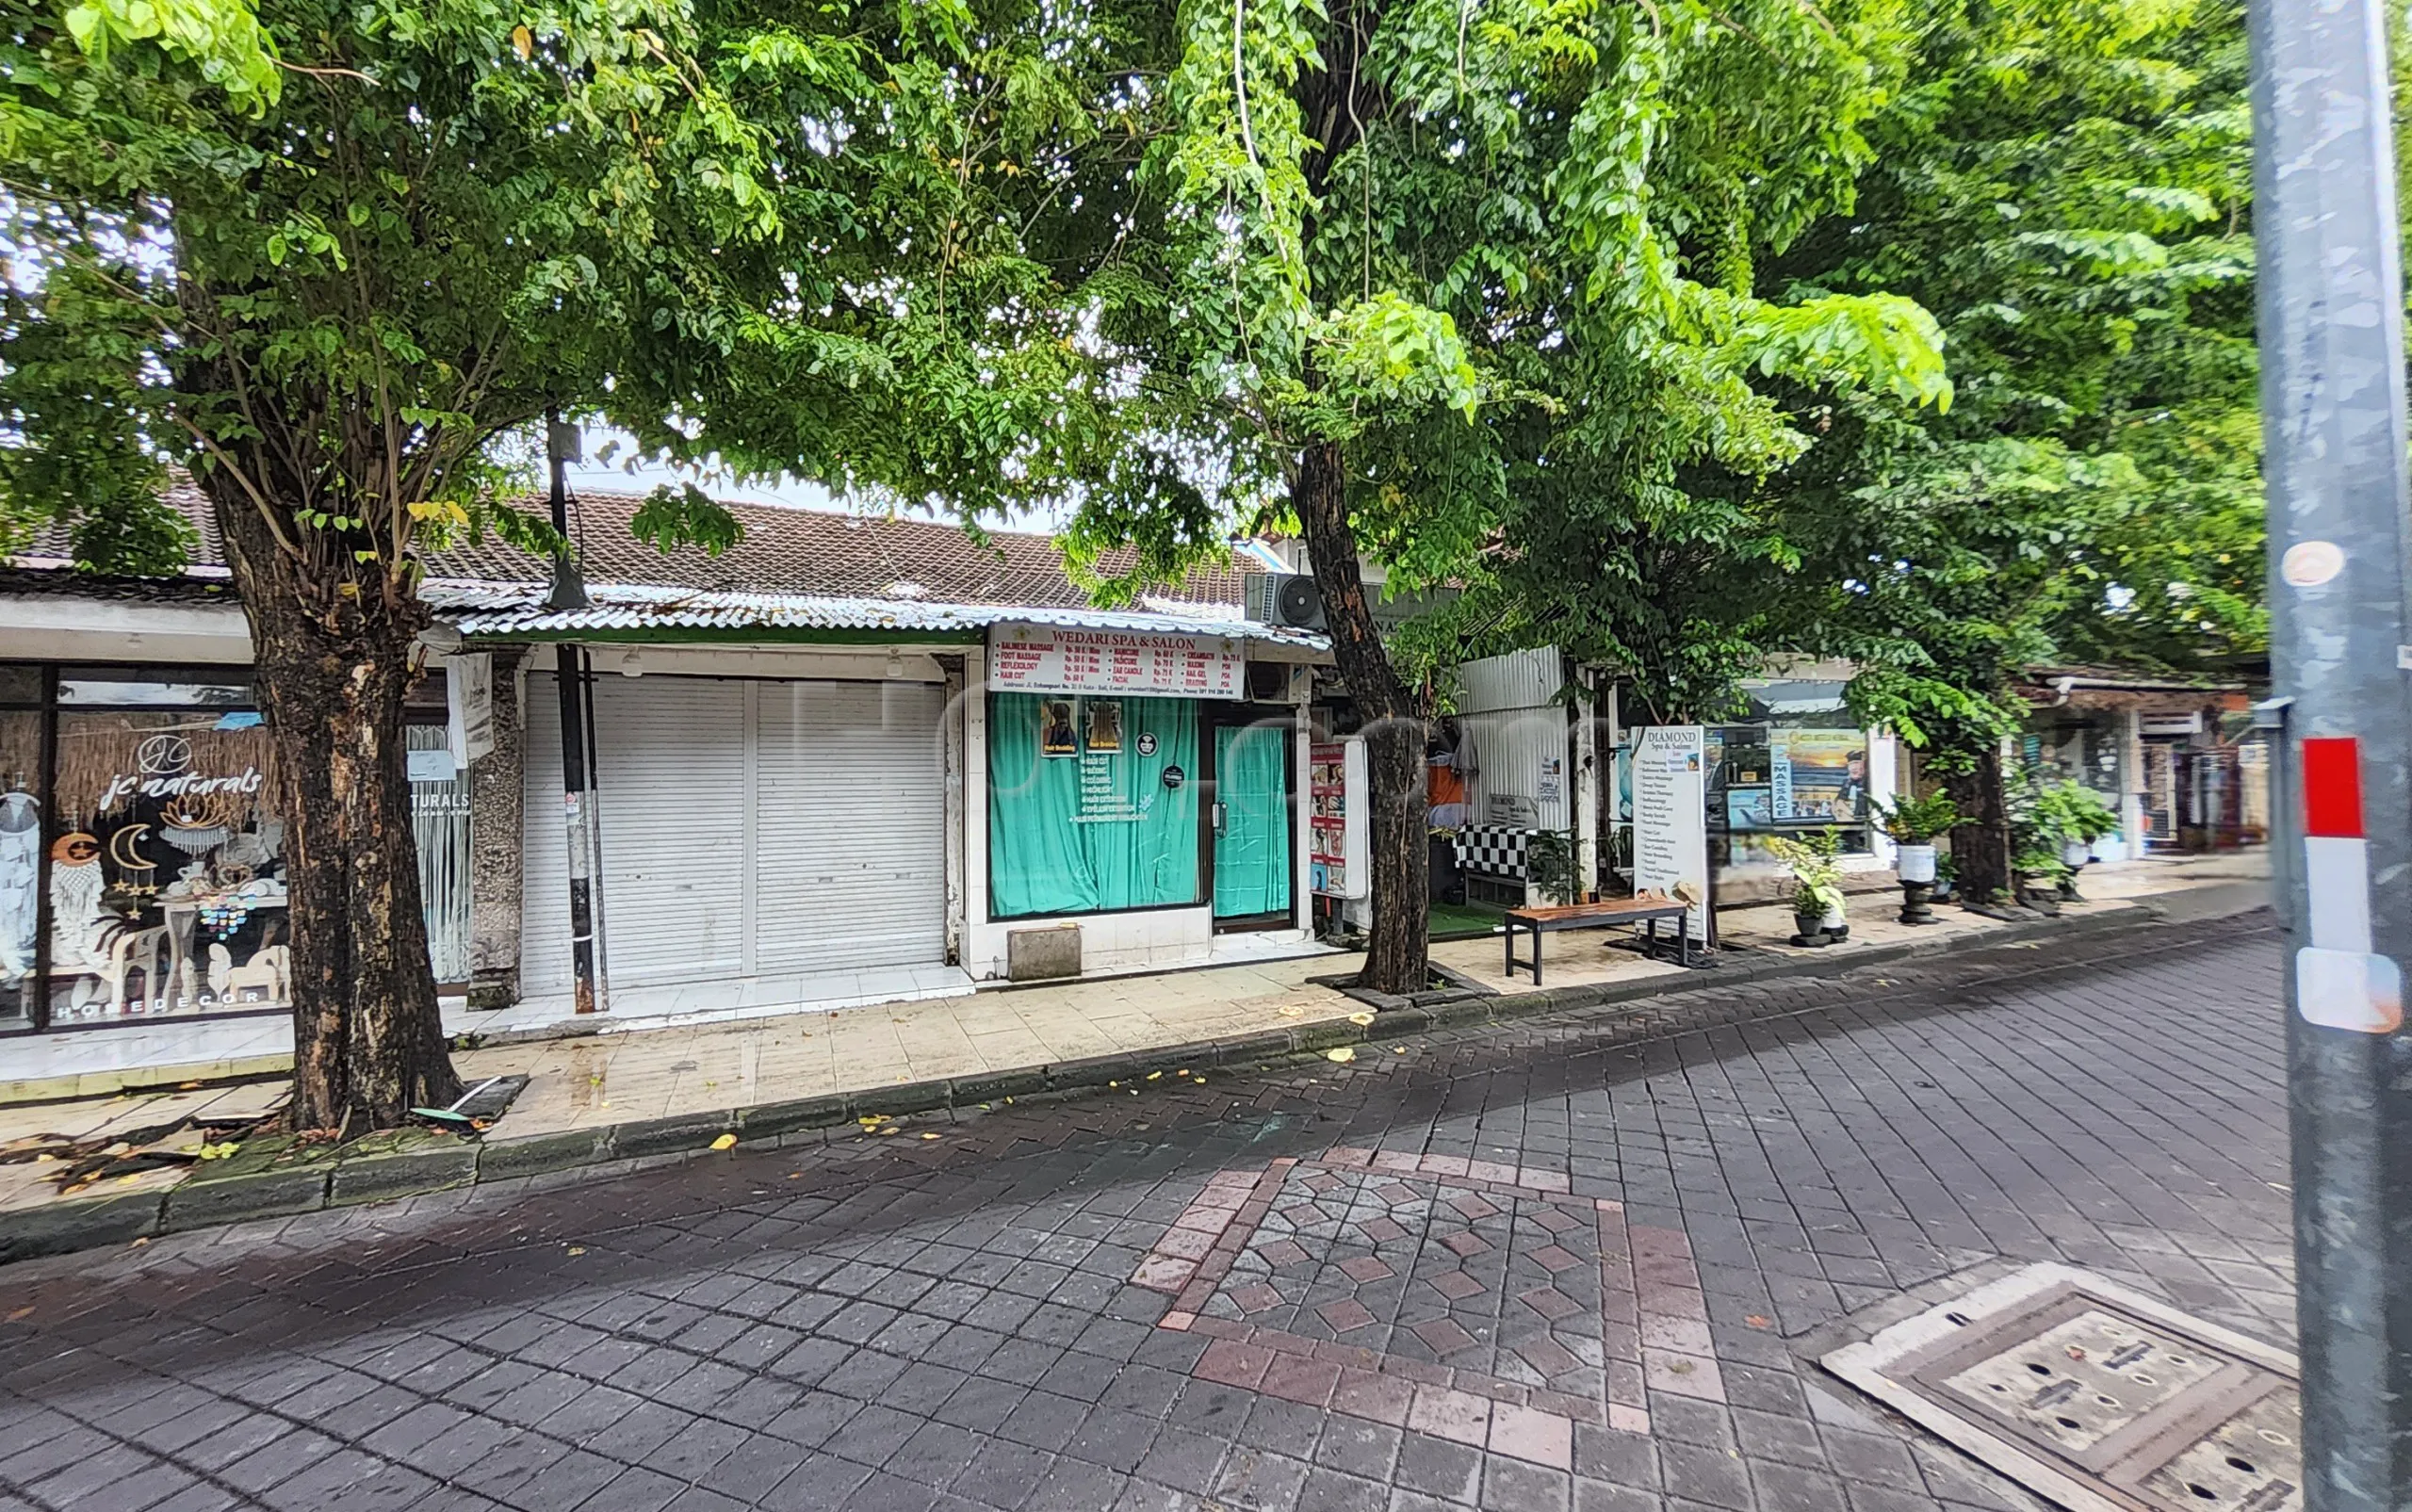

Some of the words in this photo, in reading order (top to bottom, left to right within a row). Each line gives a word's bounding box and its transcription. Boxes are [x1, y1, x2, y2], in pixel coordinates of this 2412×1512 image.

[1052, 630, 1109, 644] WEDARI
[1112, 634, 1139, 646] SPA
[1139, 636, 1149, 646] &
[1151, 637, 1196, 649] SALON
[1029, 642, 1054, 652] MASSAGE
[1017, 652, 1042, 661] MASSAGE
[1001, 660, 1038, 670] REFLEXOLOGY
[1648, 732, 1696, 742] DIAMOND
[1652, 742, 1663, 752] Spa
[139, 766, 262, 798] naturals
[1773, 765, 1788, 817] MASSAGE
[410, 793, 470, 808] TURALS
[154, 991, 260, 1010] DECOR
